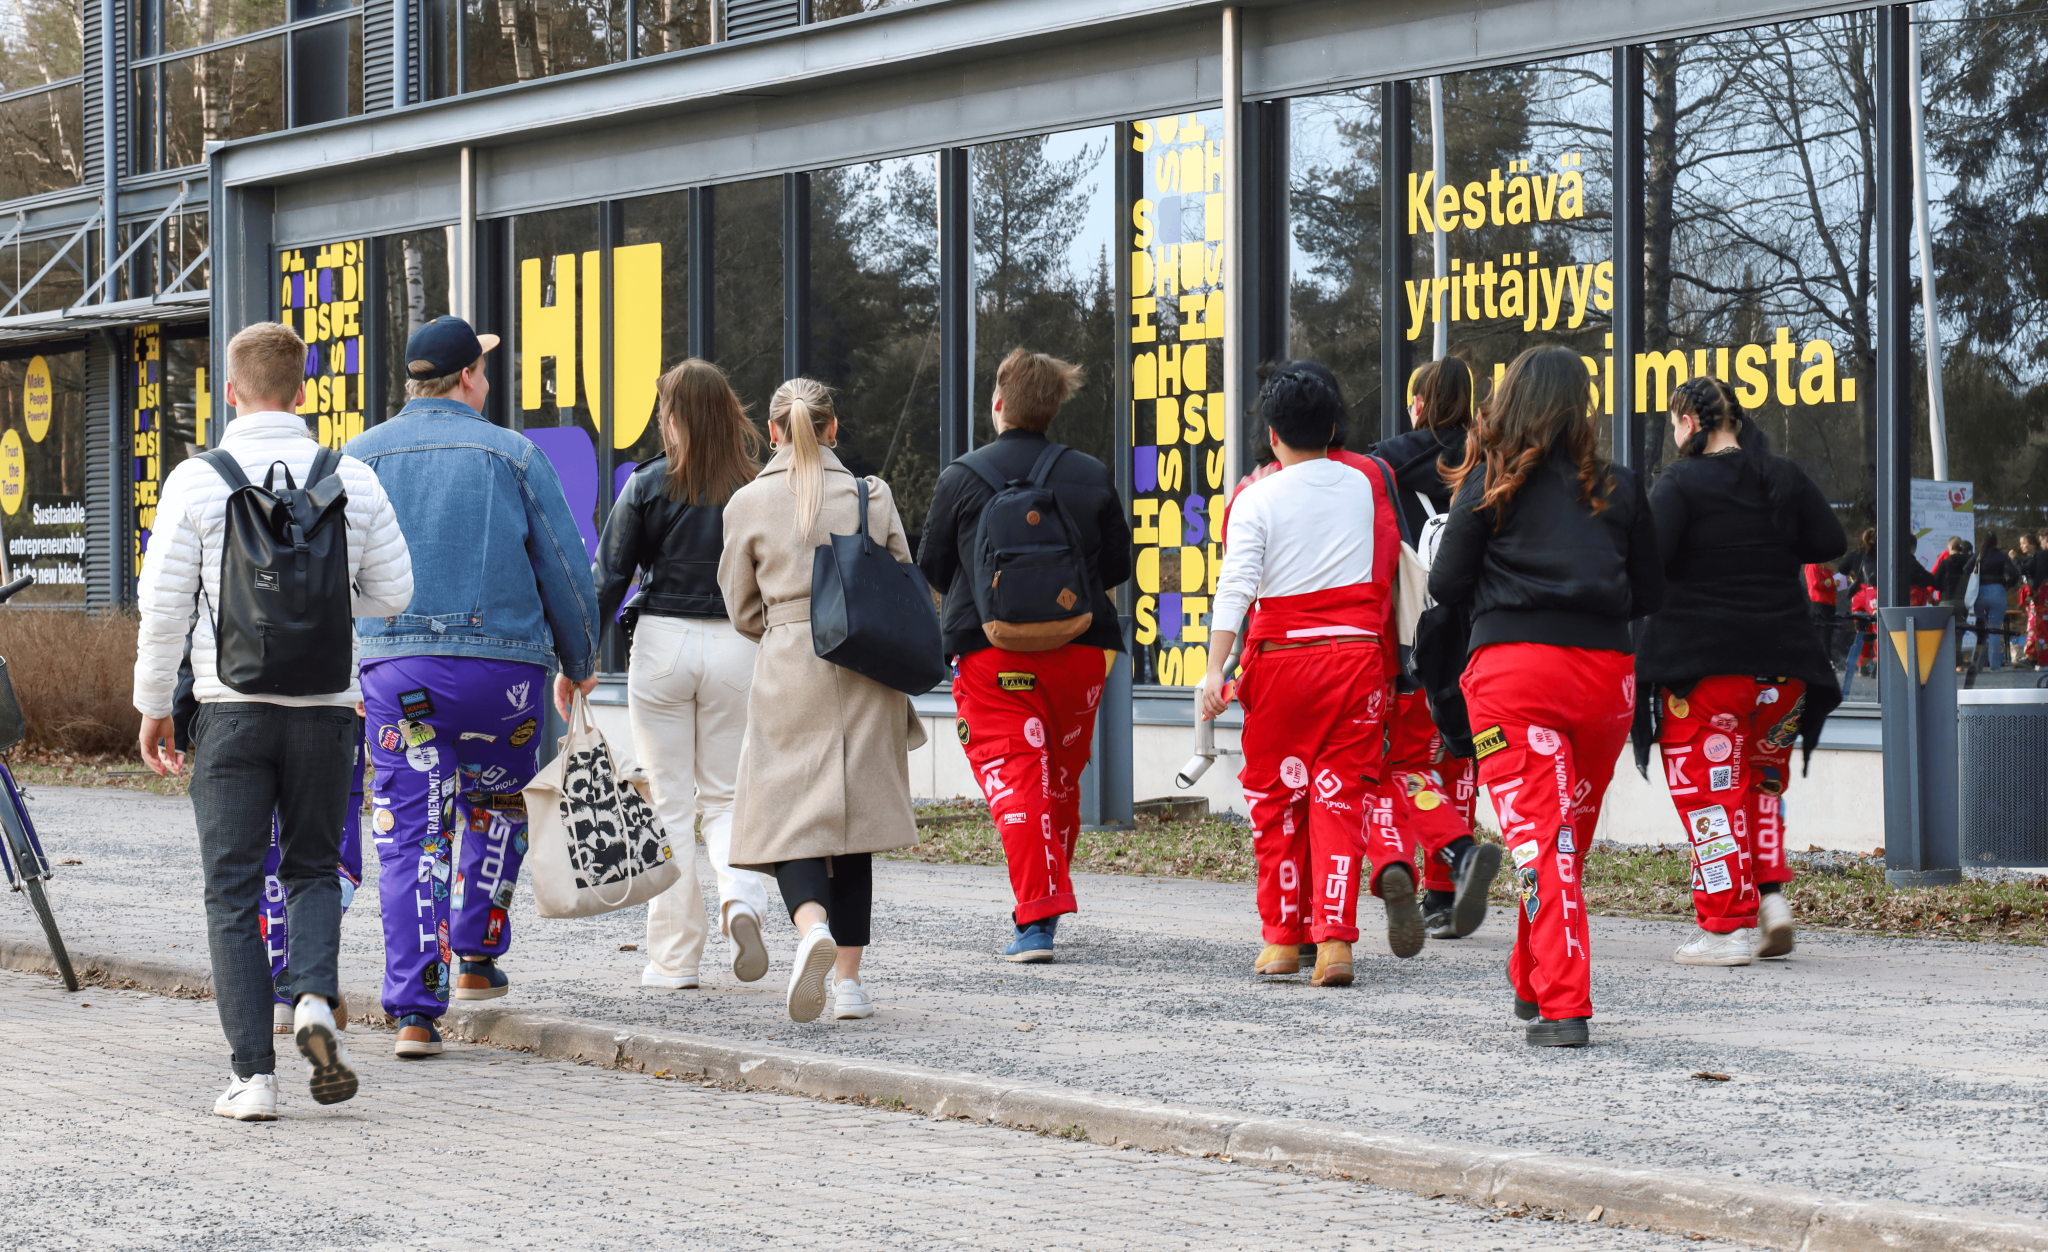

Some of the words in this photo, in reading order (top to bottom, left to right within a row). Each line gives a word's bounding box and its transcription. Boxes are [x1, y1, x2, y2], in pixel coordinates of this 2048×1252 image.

[1408, 153, 1584, 235] Kestävä
[1405, 251, 1614, 342] yrittäjyys
[28, 373, 45, 388] Make
[30, 391, 48, 407] People
[28, 409, 49, 422] Powerful
[4, 444, 19, 457] Trust
[9, 463, 19, 478] the
[2, 480, 19, 495] Team
[33, 501, 85, 525] Sustainable
[9, 531, 86, 559] entrepreneurship
[13, 563, 21, 583] is
[38, 568, 57, 584] new
[58, 562, 86, 585] black.
[1286, 765, 1294, 777] NO
